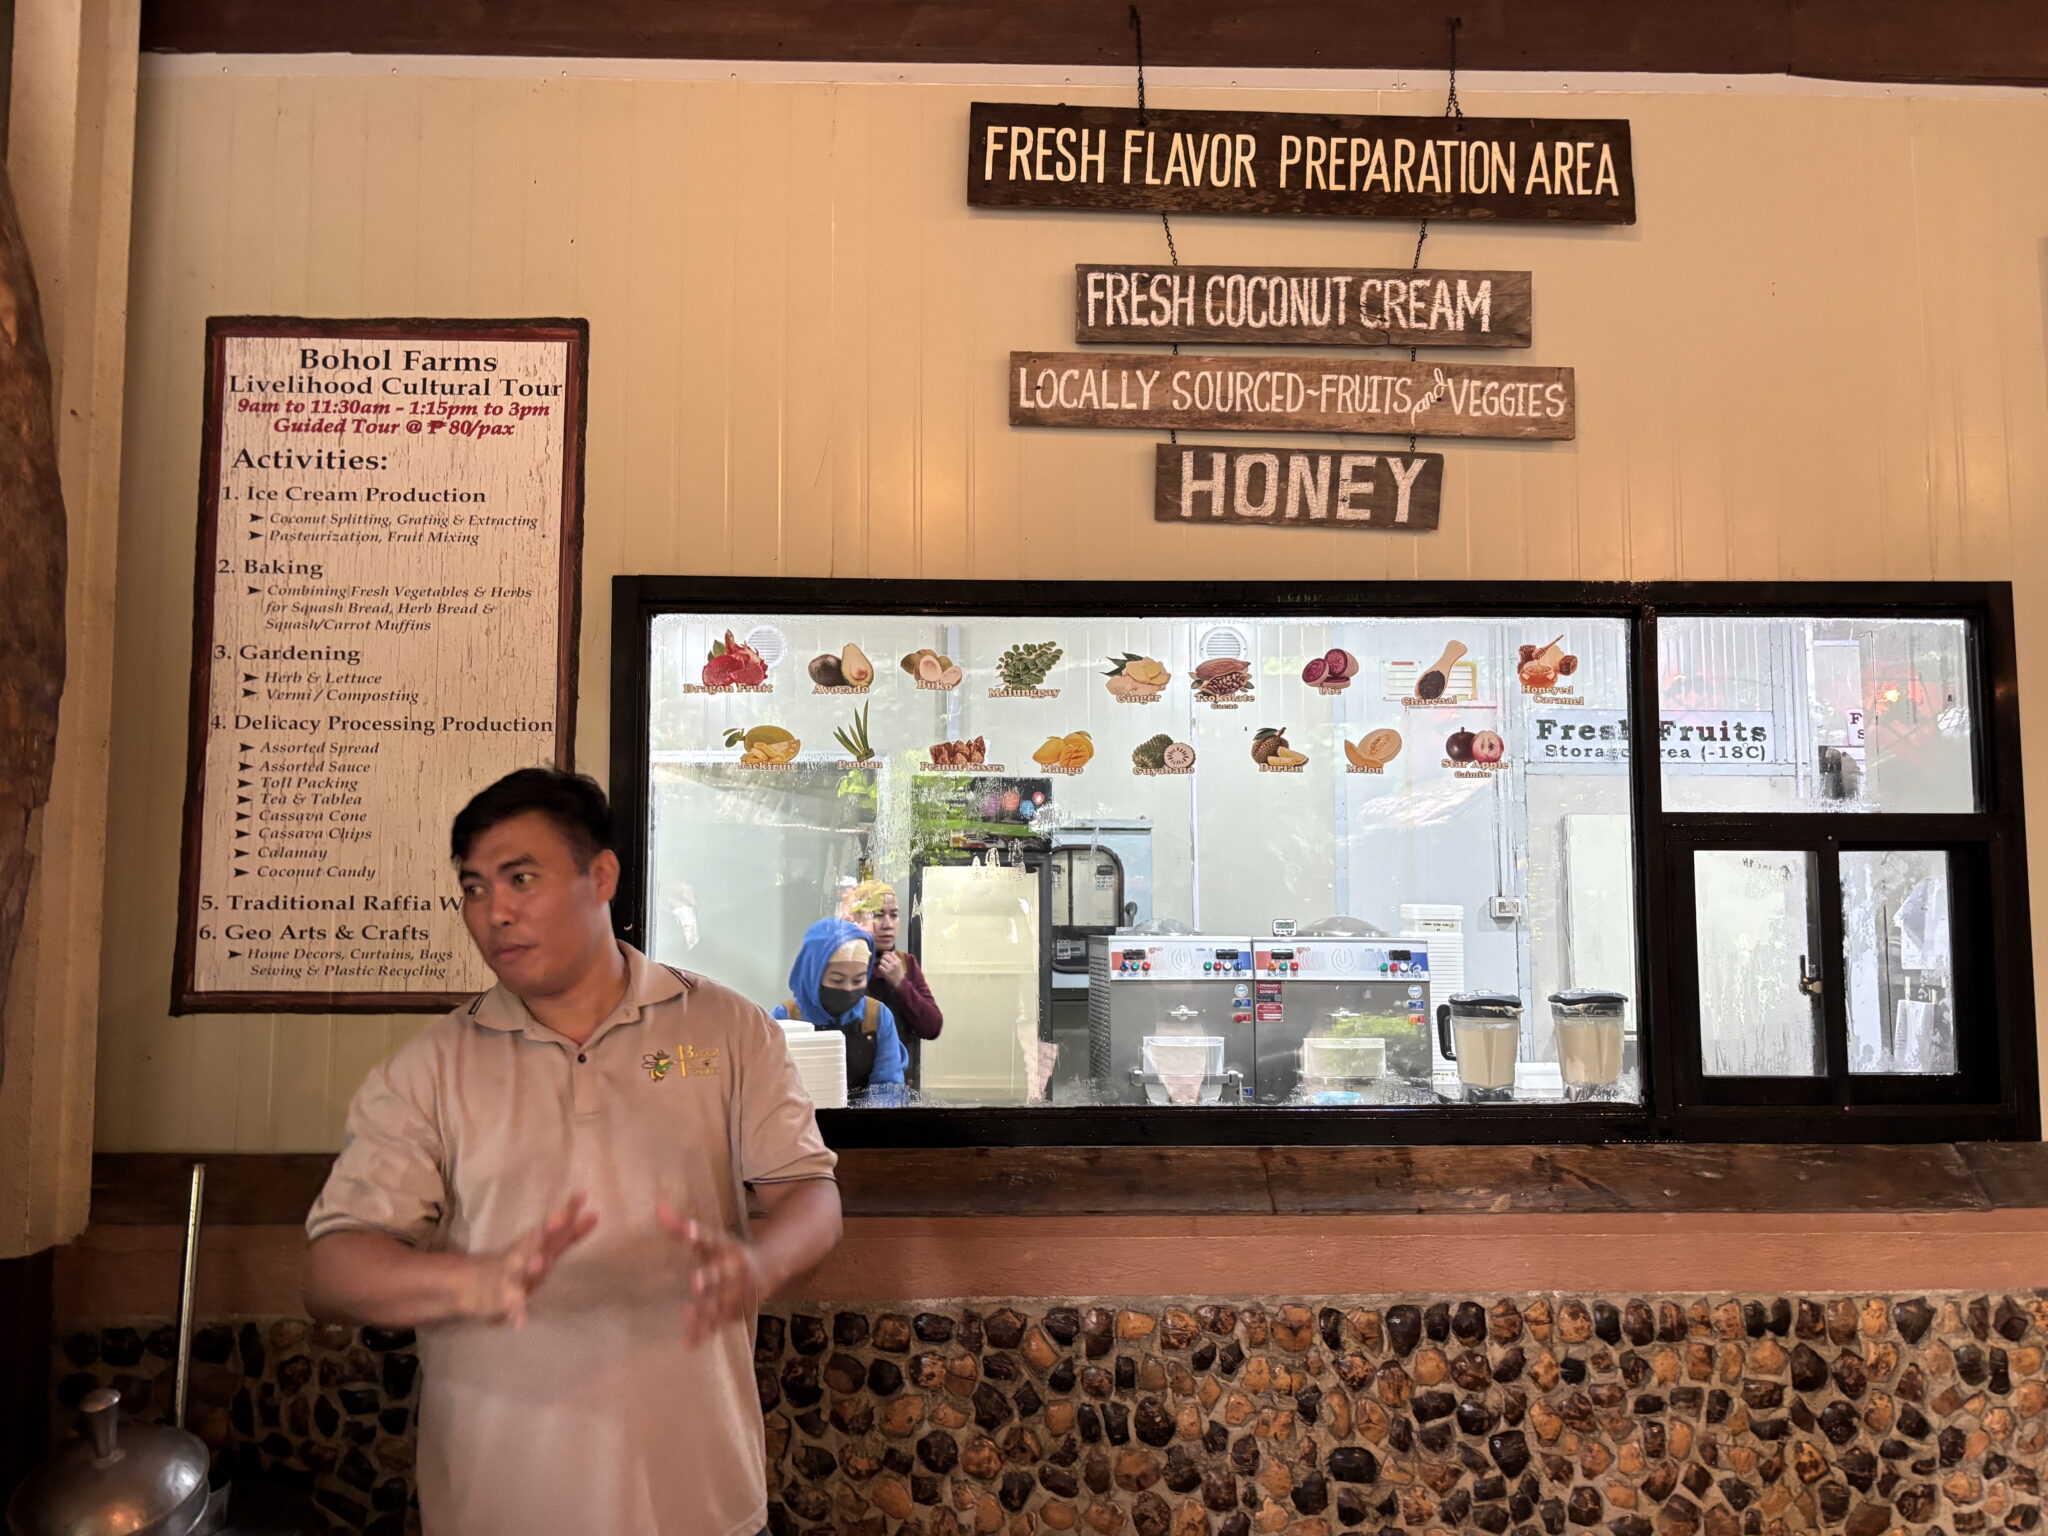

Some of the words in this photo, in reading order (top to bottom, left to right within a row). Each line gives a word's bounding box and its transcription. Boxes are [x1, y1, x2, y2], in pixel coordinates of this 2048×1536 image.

[984, 126, 1105, 184] FRESH
[1123, 129, 1256, 188] FLAVOR
[1280, 135, 1515, 195] PREPARATION
[1525, 142, 1619, 196] AREA
[1086, 272, 1195, 327] FRESH
[1204, 275, 1353, 329] COCONUT
[1360, 278, 1491, 332] CREAM
[300, 349, 390, 371] Bohol
[404, 350, 497, 372] Farms
[229, 375, 372, 394] Livelihood
[382, 377, 490, 396] Cultural
[500, 379, 562, 397] Tour
[1019, 368, 1159, 410] LOCALLY
[1411, 369, 1447, 423] and
[1448, 380, 1566, 418] VEGGIES
[237, 399, 279, 413] 9am
[286, 400, 305, 414] to
[311, 400, 390, 414] 11:30am
[410, 402, 478, 418] 1:15pm
[484, 402, 503, 415] to
[509, 402, 550, 418] 3pm
[274, 418, 346, 433] Guided
[352, 419, 399, 434] Tour
[406, 420, 422, 434] @
[232, 448, 387, 471] Activities:
[1180, 450, 1427, 523] HONEY
[223, 486, 238, 500] 1.
[248, 486, 277, 501] Ice
[286, 487, 357, 501] Cream
[366, 487, 486, 502] Production
[270, 513, 326, 525] Coconut
[330, 513, 391, 527] Splitting,
[397, 514, 448, 527] Grating
[453, 515, 463, 526] &
[469, 515, 538, 528] Extracting
[269, 530, 381, 543] Pasteurization,
[388, 531, 423, 543] Fruit
[428, 532, 479, 545] Mixing
[219, 559, 235, 573] 2.
[245, 559, 323, 578] Baking
[267, 585, 346, 598] Combining
[351, 586, 389, 597] Fresh
[394, 586, 469, 599] Vegetables
[474, 587, 485, 597] &
[491, 587, 532, 598] Herbs
[265, 603, 288, 615] for
[292, 603, 343, 615] Squash
[348, 603, 393, 615] Bread,
[398, 603, 432, 614] Herb
[437, 603, 477, 614] Bread
[482, 604, 493, 614] &
[265, 619, 371, 632] Squash/Carrot
[375, 620, 431, 633] Muffins
[214, 646, 231, 659] 3.
[240, 645, 360, 664] Gardening
[265, 672, 301, 684] Herb
[307, 673, 320, 683] &
[325, 673, 381, 684] Lettuce
[683, 684, 733, 695] Dragon
[737, 683, 773, 693] Fruit
[812, 684, 869, 694] Avocado
[917, 680, 953, 690] Buko
[1319, 687, 1342, 695] Ube
[1521, 685, 1573, 695] Honeyed
[326, 690, 419, 703] Composting
[988, 688, 1061, 699] Malunggay
[1116, 694, 1161, 705] Ginger
[1195, 694, 1255, 703] Tsokolate
[1401, 695, 1457, 705] Charcoal
[1532, 694, 1584, 705] Caramel
[210, 715, 226, 729] 4.
[234, 715, 320, 734] Delicacy
[328, 716, 435, 735] Processing
[442, 717, 553, 732] Production
[1659, 720, 1767, 742] Fruits
[260, 742, 324, 753] Assorted
[330, 742, 379, 755] Spread
[259, 761, 324, 773] Assorted
[329, 761, 370, 773] Sauce
[737, 762, 797, 772] Jackfruit
[837, 760, 883, 769] Pandan
[920, 762, 964, 772] Peanut
[966, 763, 1005, 772] Kisses
[1041, 764, 1082, 775] Mango
[1133, 766, 1195, 776] Guyabano
[1259, 763, 1303, 773] Durian
[1346, 764, 1383, 774] Melon
[1441, 759, 1470, 769] Star
[1471, 760, 1509, 770] Apple
[1454, 771, 1492, 779] Caimito
[261, 777, 292, 789] Toll
[297, 777, 358, 792] Packing
[261, 794, 288, 805] Tea
[293, 794, 306, 805] &
[312, 794, 361, 805] Tablea
[259, 811, 323, 822] Cassava
[329, 811, 366, 822] Cone
[259, 828, 324, 840] Cassava
[329, 828, 372, 841] Chips
[257, 847, 327, 861] Calamay
[257, 866, 322, 879] Coconut
[327, 867, 376, 881] Candy
[201, 896, 218, 910] 5.
[227, 895, 355, 911] Traditional
[363, 896, 431, 911] Raffia
[199, 925, 216, 939] 6.
[225, 925, 271, 940] Geo
[280, 925, 326, 940] Arts
[335, 925, 353, 940] &
[361, 925, 429, 940] Crafts
[247, 948, 289, 960] Home
[294, 949, 345, 961] Decors,
[350, 949, 414, 962] Curtains,
[420, 950, 452, 962] Bags
[250, 965, 302, 978] Sewing
[307, 966, 318, 976] &
[324, 965, 372, 976] Plastic
[378, 966, 445, 979] Recycling
